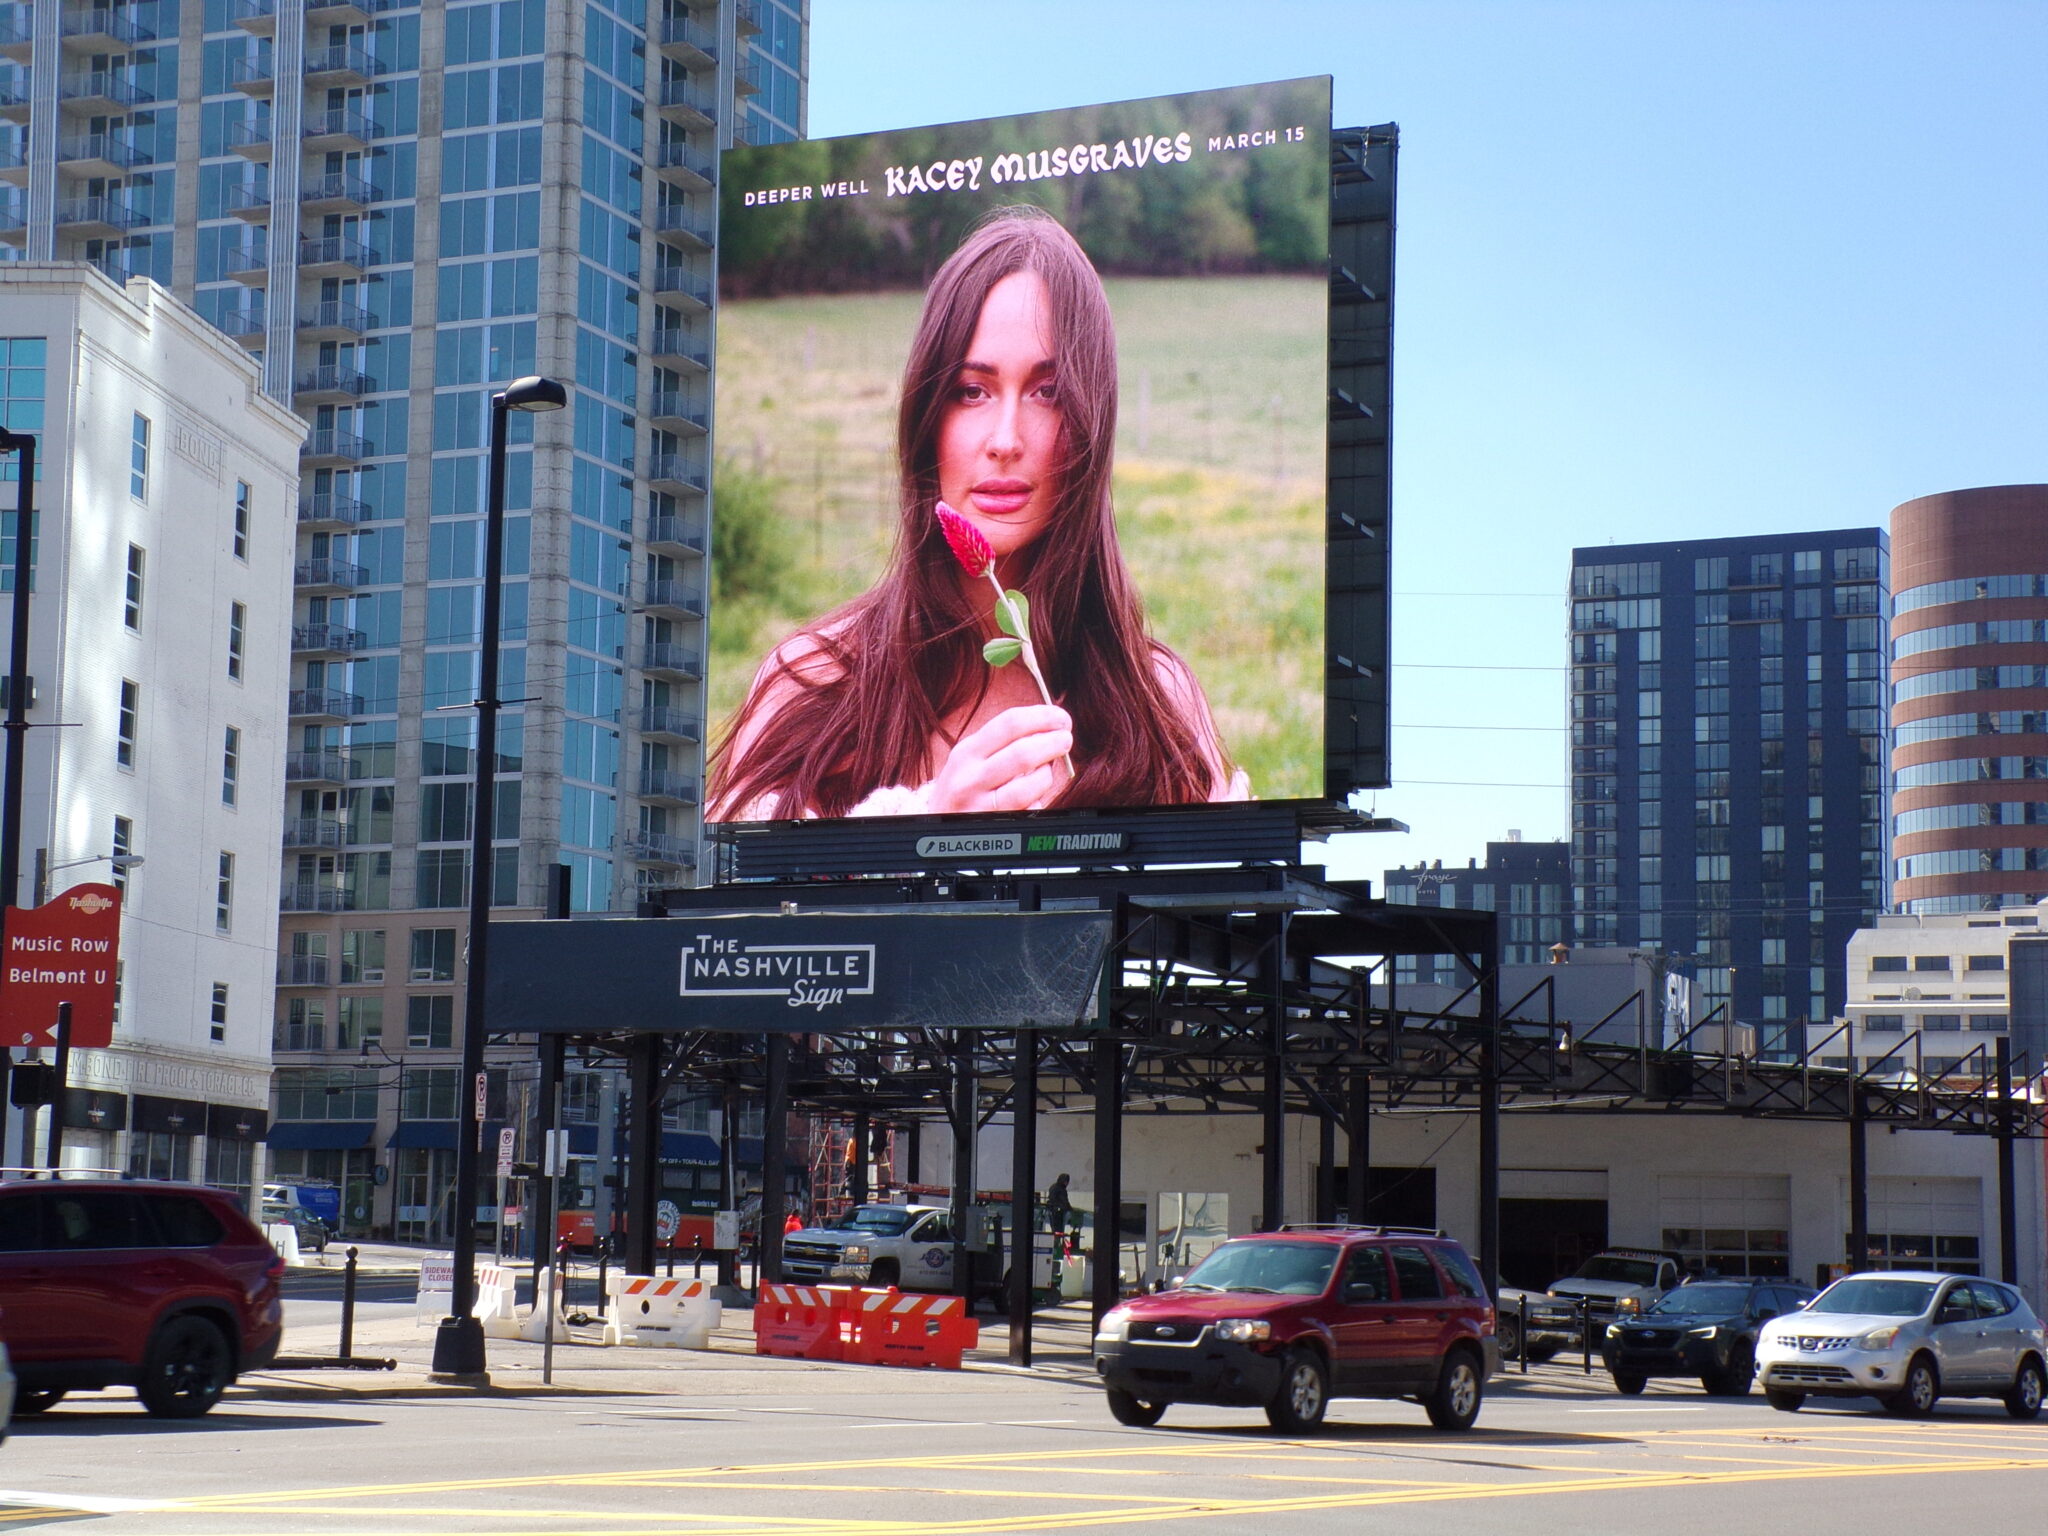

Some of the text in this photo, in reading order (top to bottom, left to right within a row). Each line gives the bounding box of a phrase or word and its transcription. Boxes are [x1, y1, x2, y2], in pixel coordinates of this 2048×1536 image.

[744, 126, 1305, 206] DEEPER WELL KACEY MUSGRAVES MARCH 15
[938, 839, 1013, 852] BLACKBIRD
[12, 936, 109, 952] Music Row
[694, 956, 859, 977] NASHVILLE
[9, 968, 106, 984] Belmont U
[787, 979, 843, 1011] Sign
[425, 1266, 455, 1274] SIDEWA
